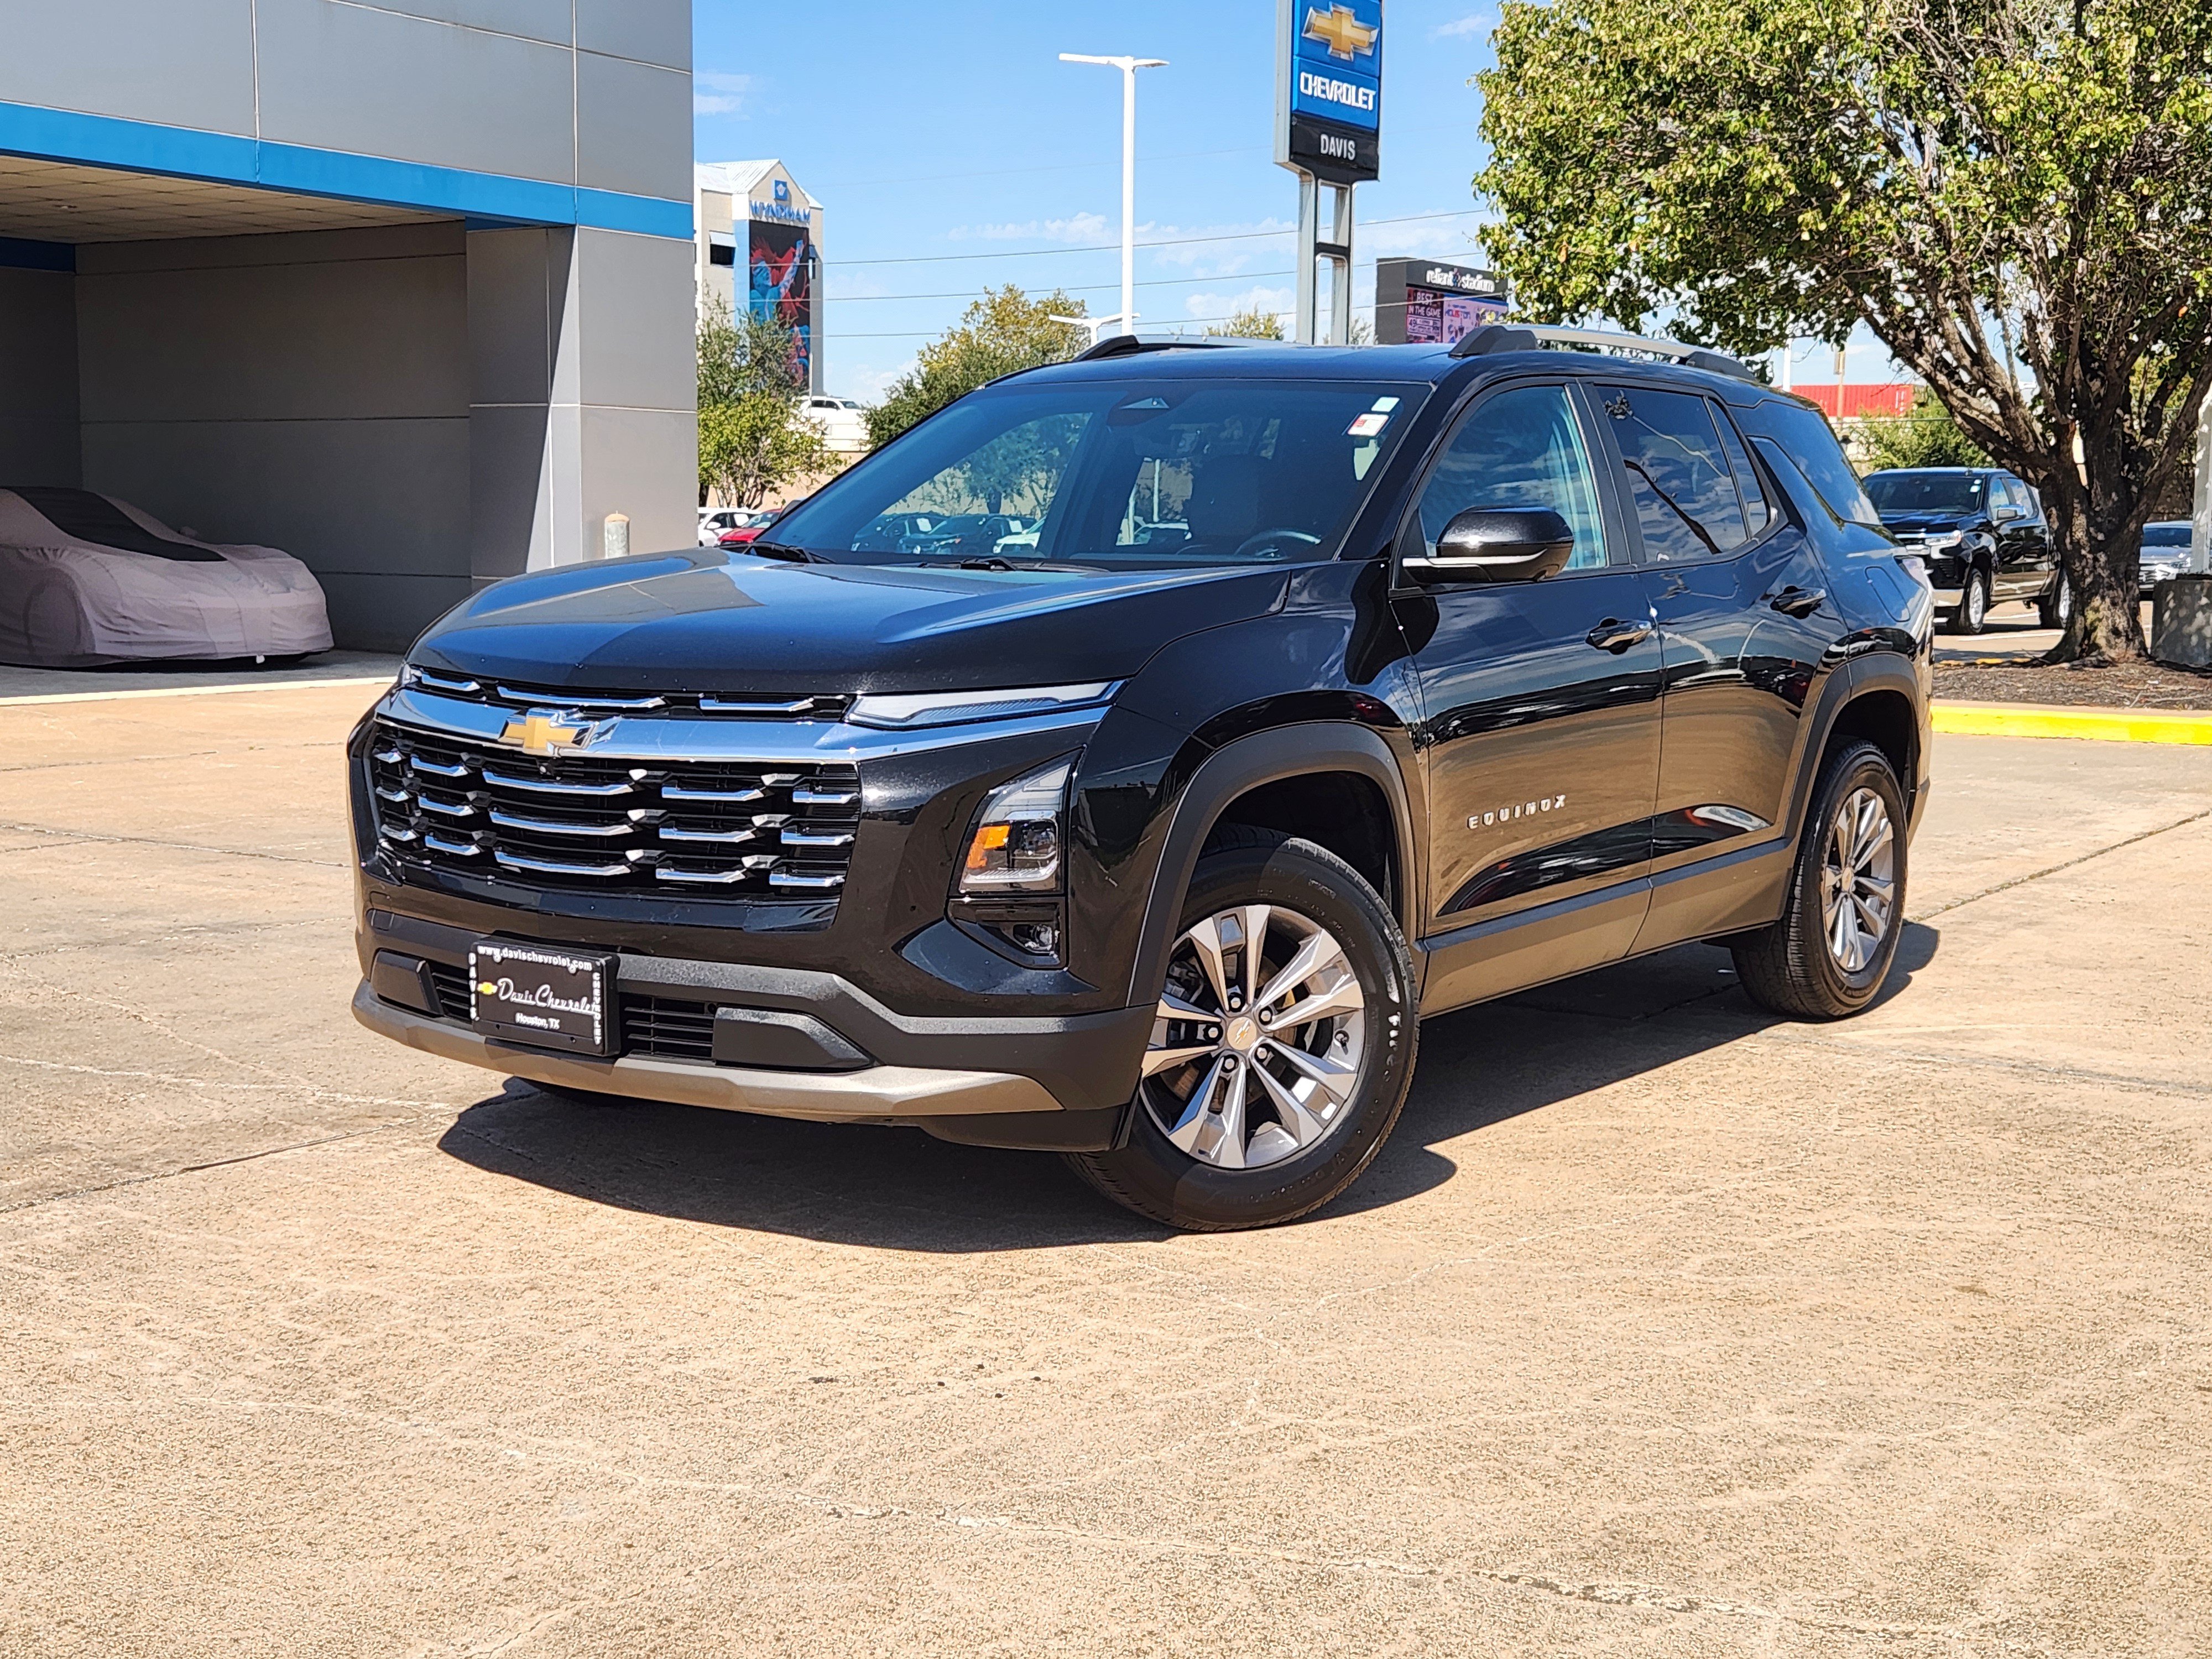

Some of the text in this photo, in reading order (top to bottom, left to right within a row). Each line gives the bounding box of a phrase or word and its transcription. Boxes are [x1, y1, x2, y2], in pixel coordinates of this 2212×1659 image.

[1300, 71, 1376, 111] CHEVROLET
[1320, 134, 1355, 160] DAVIS
[749, 200, 810, 222] WYNDHAM
[1461, 274, 1495, 293] stadium
[1417, 292, 1433, 305] BEST
[1415, 306, 1425, 316] THE
[1426, 307, 1441, 318] GAME
[1468, 795, 1566, 830] EQUINOX
[477, 945, 593, 971] www.davischevrolet.com
[497, 978, 596, 1016] Davis Chevrolet
[593, 972, 601, 1045] CHEVROLET
[515, 1013, 560, 1030] Houston, TX
